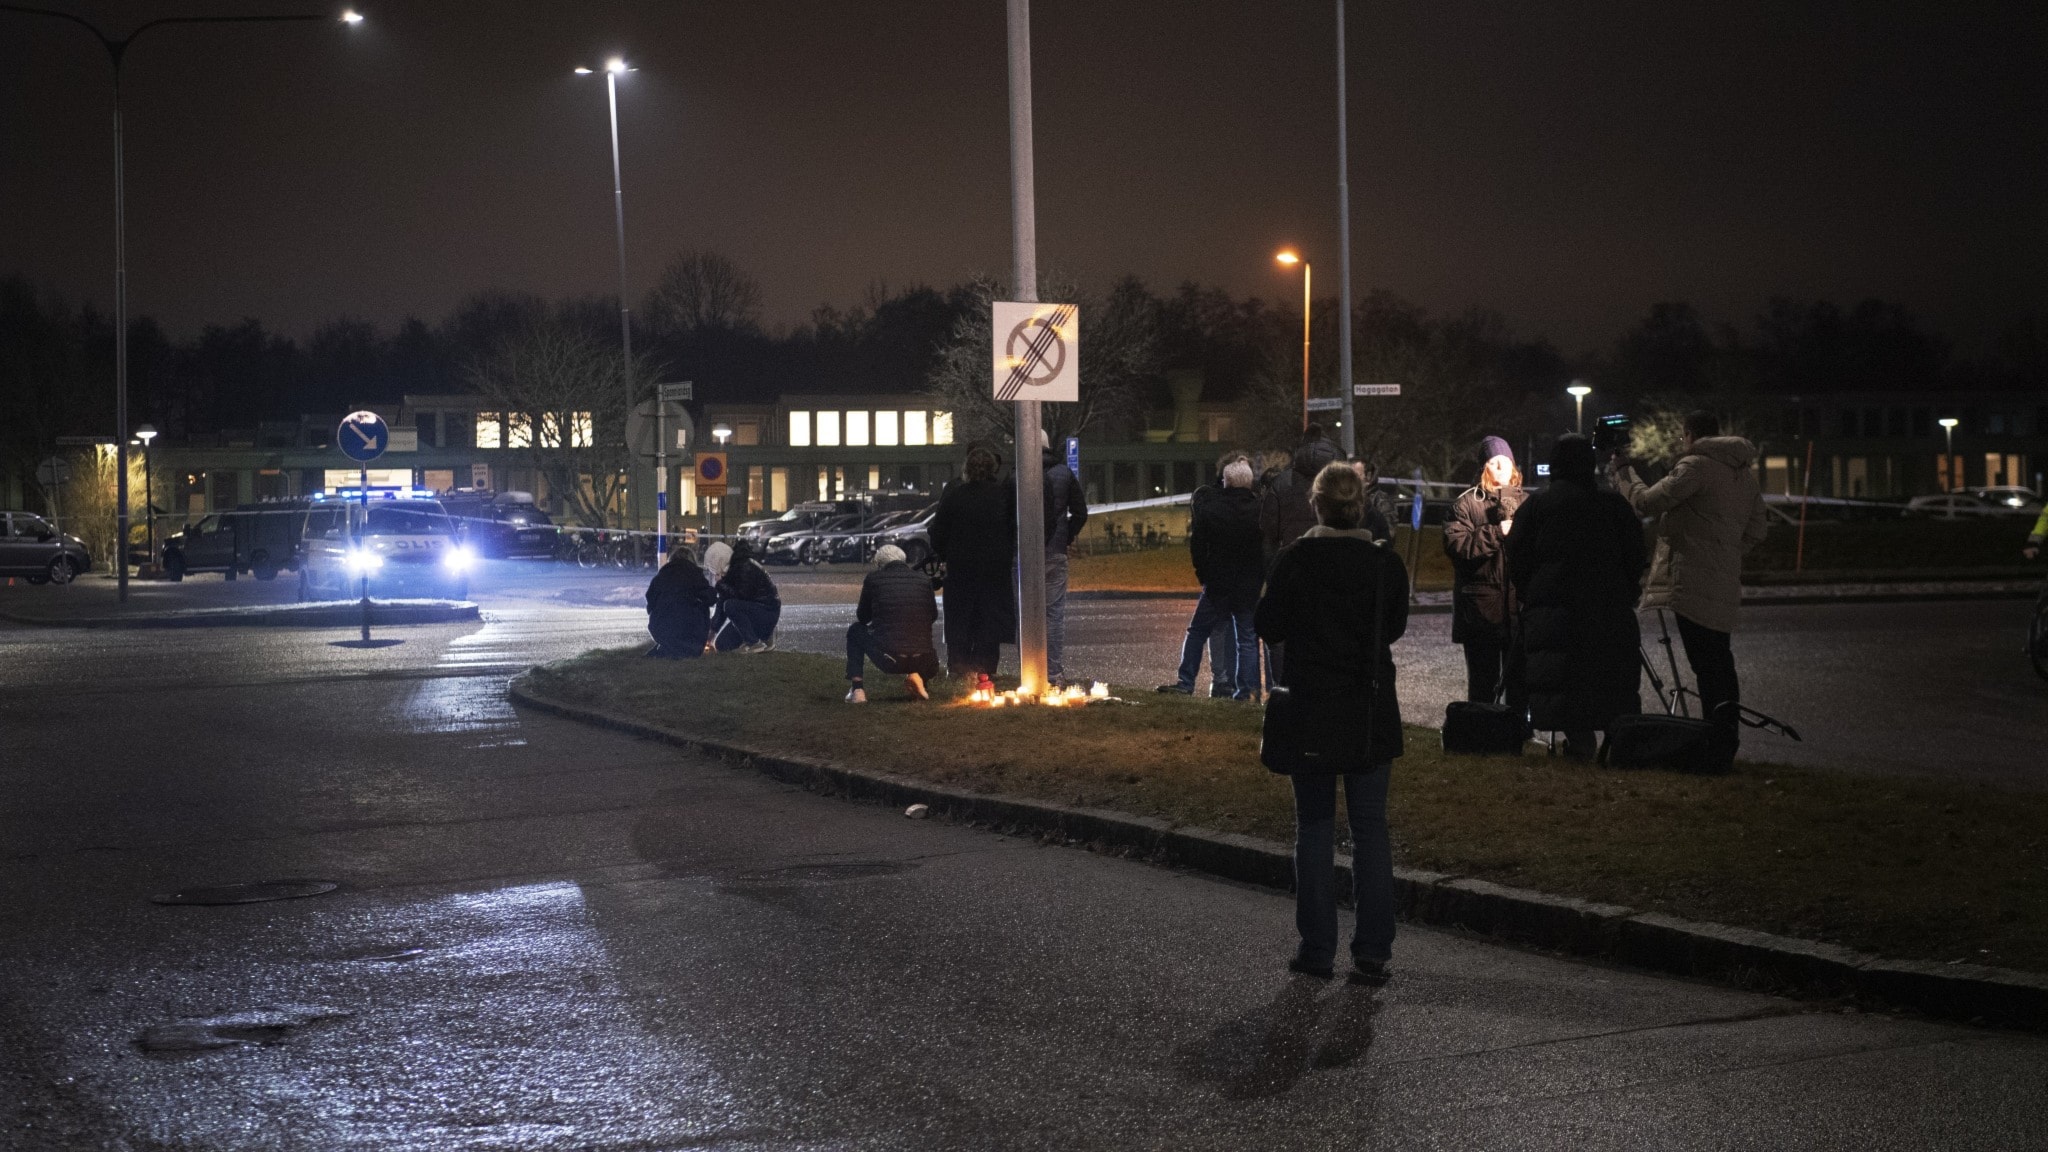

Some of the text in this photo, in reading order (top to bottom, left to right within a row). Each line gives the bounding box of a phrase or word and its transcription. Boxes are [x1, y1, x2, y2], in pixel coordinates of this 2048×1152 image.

[1355, 386, 1398, 394] Hagagatan
[1069, 440, 1077, 455] P
[384, 540, 442, 549] OLIS
